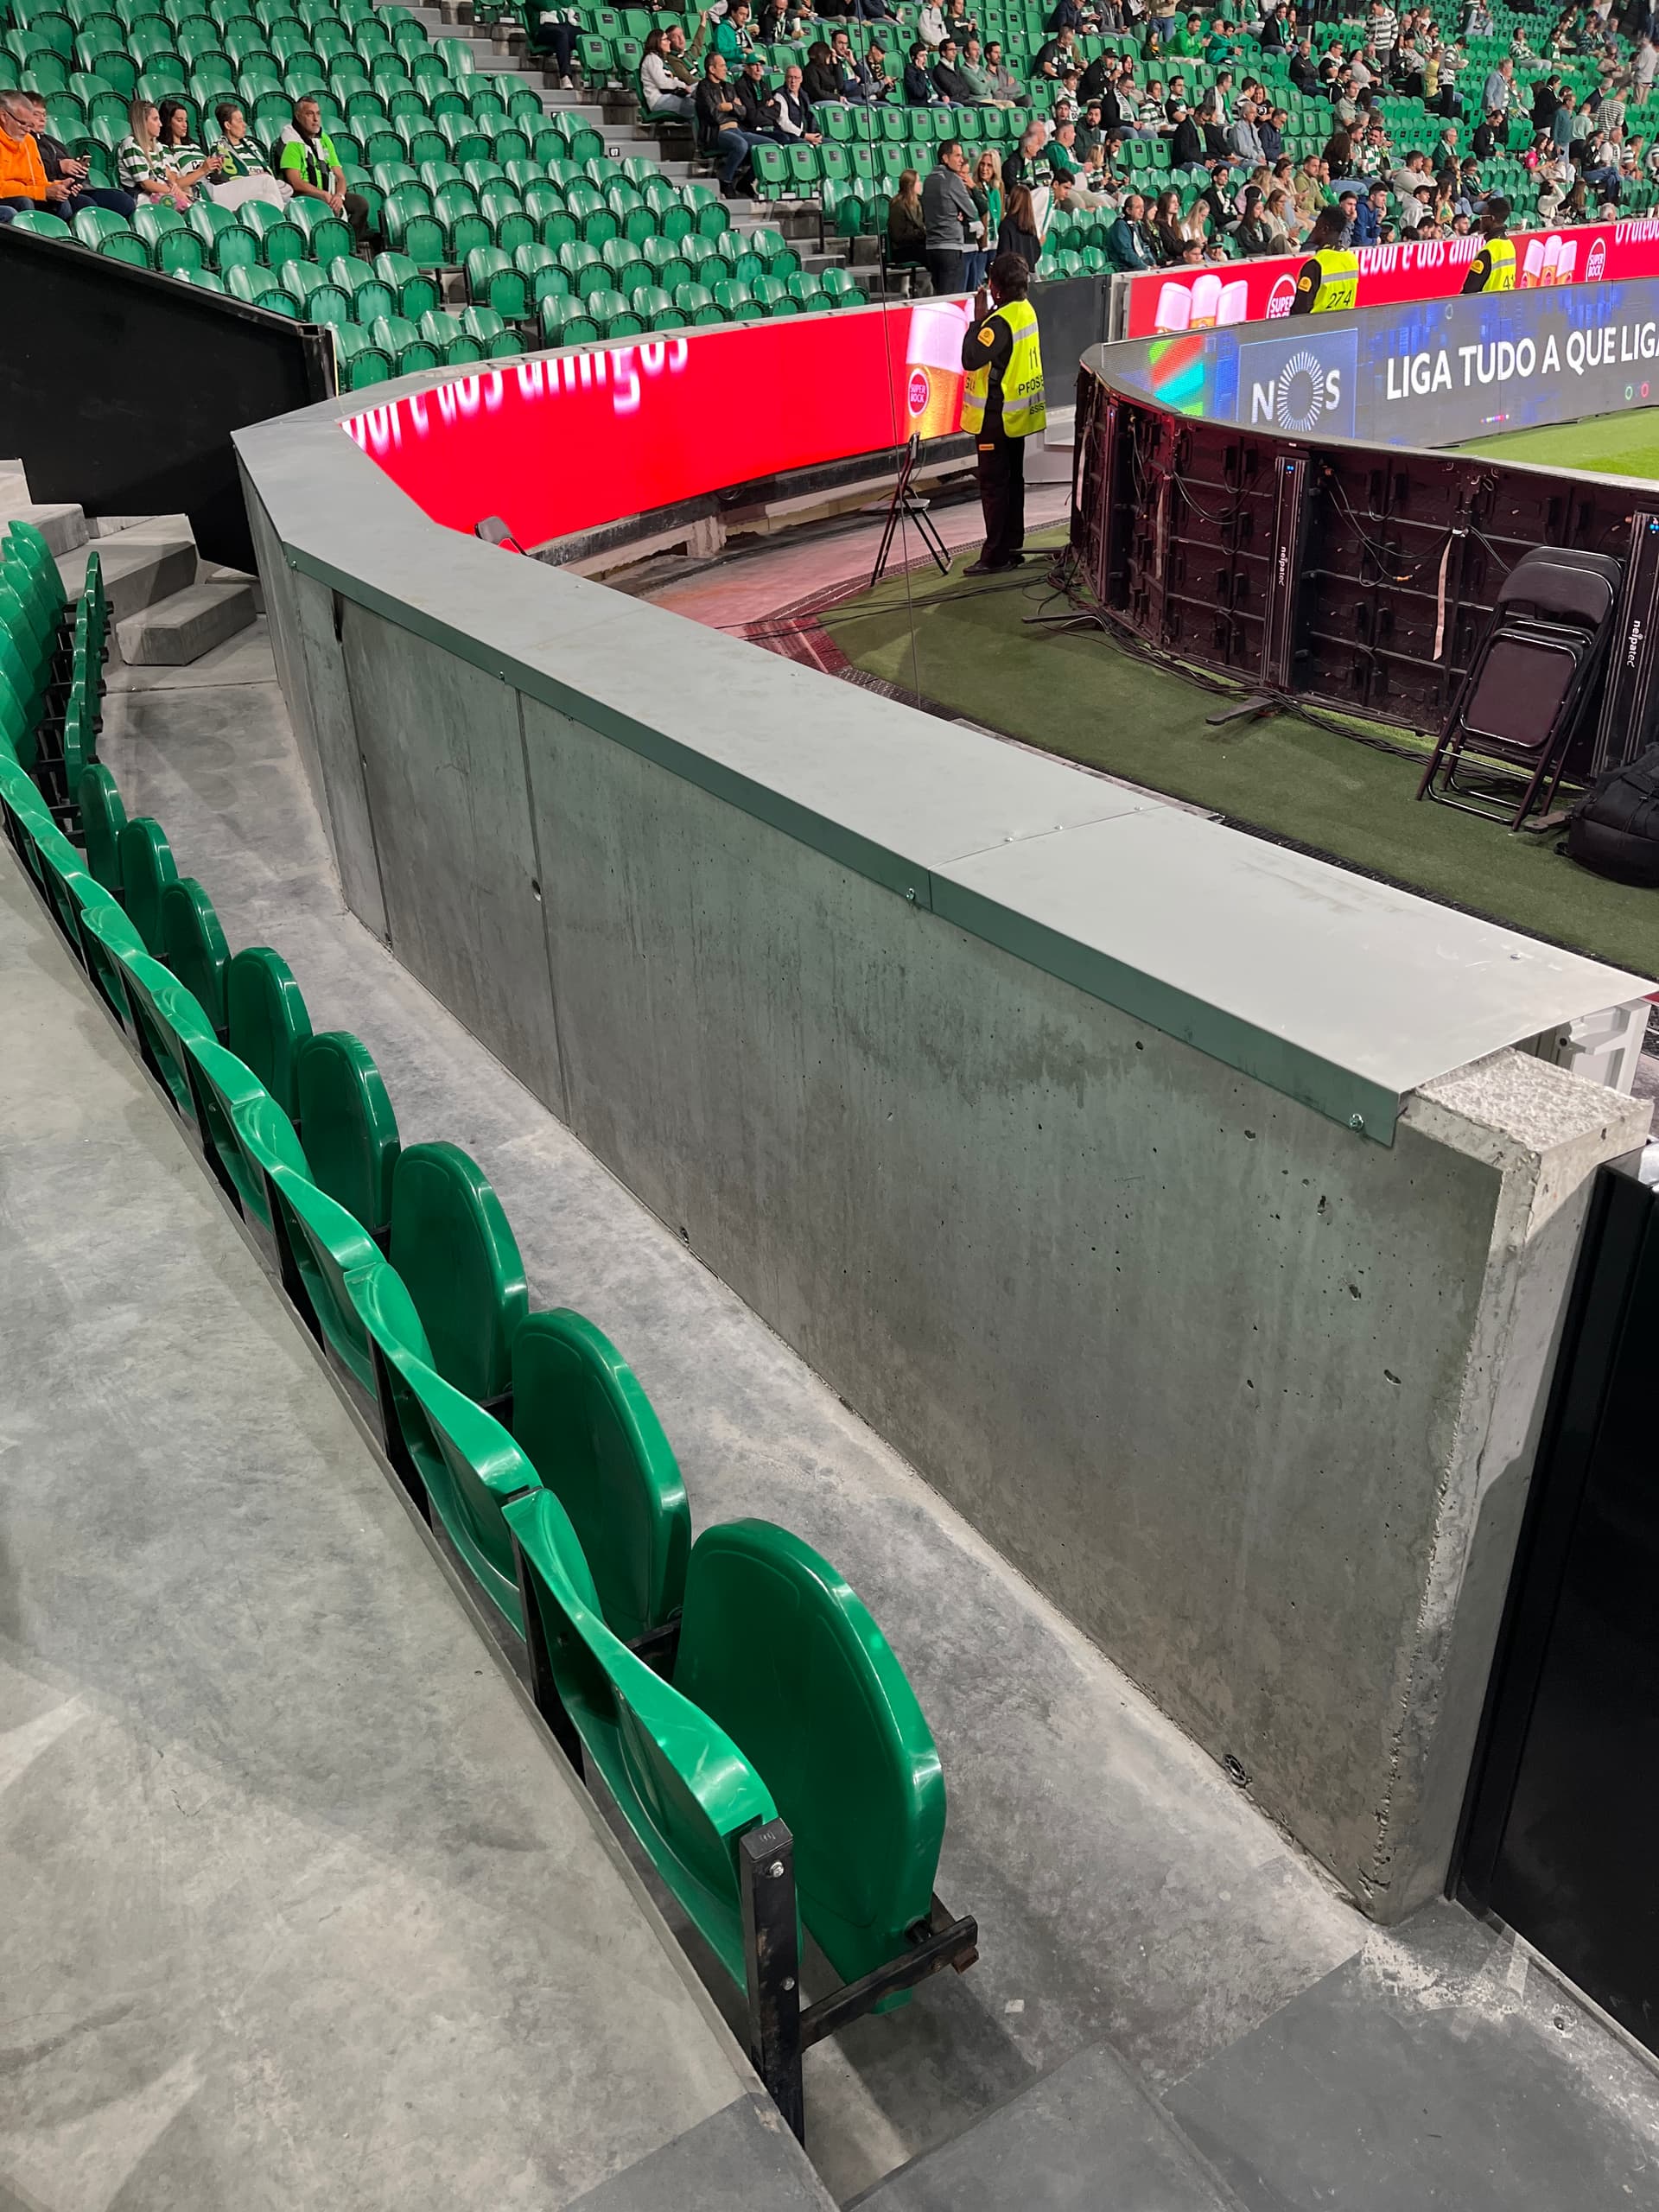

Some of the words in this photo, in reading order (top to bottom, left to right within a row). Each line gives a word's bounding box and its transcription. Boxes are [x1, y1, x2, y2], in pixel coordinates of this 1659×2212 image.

[1325, 289, 1352, 309] 274
[1251, 351, 1340, 432] NOS
[1387, 349, 1452, 400] LIGA
[1459, 338, 1536, 387] TUDO
[1541, 334, 1560, 374] A
[1566, 327, 1617, 376] QUE
